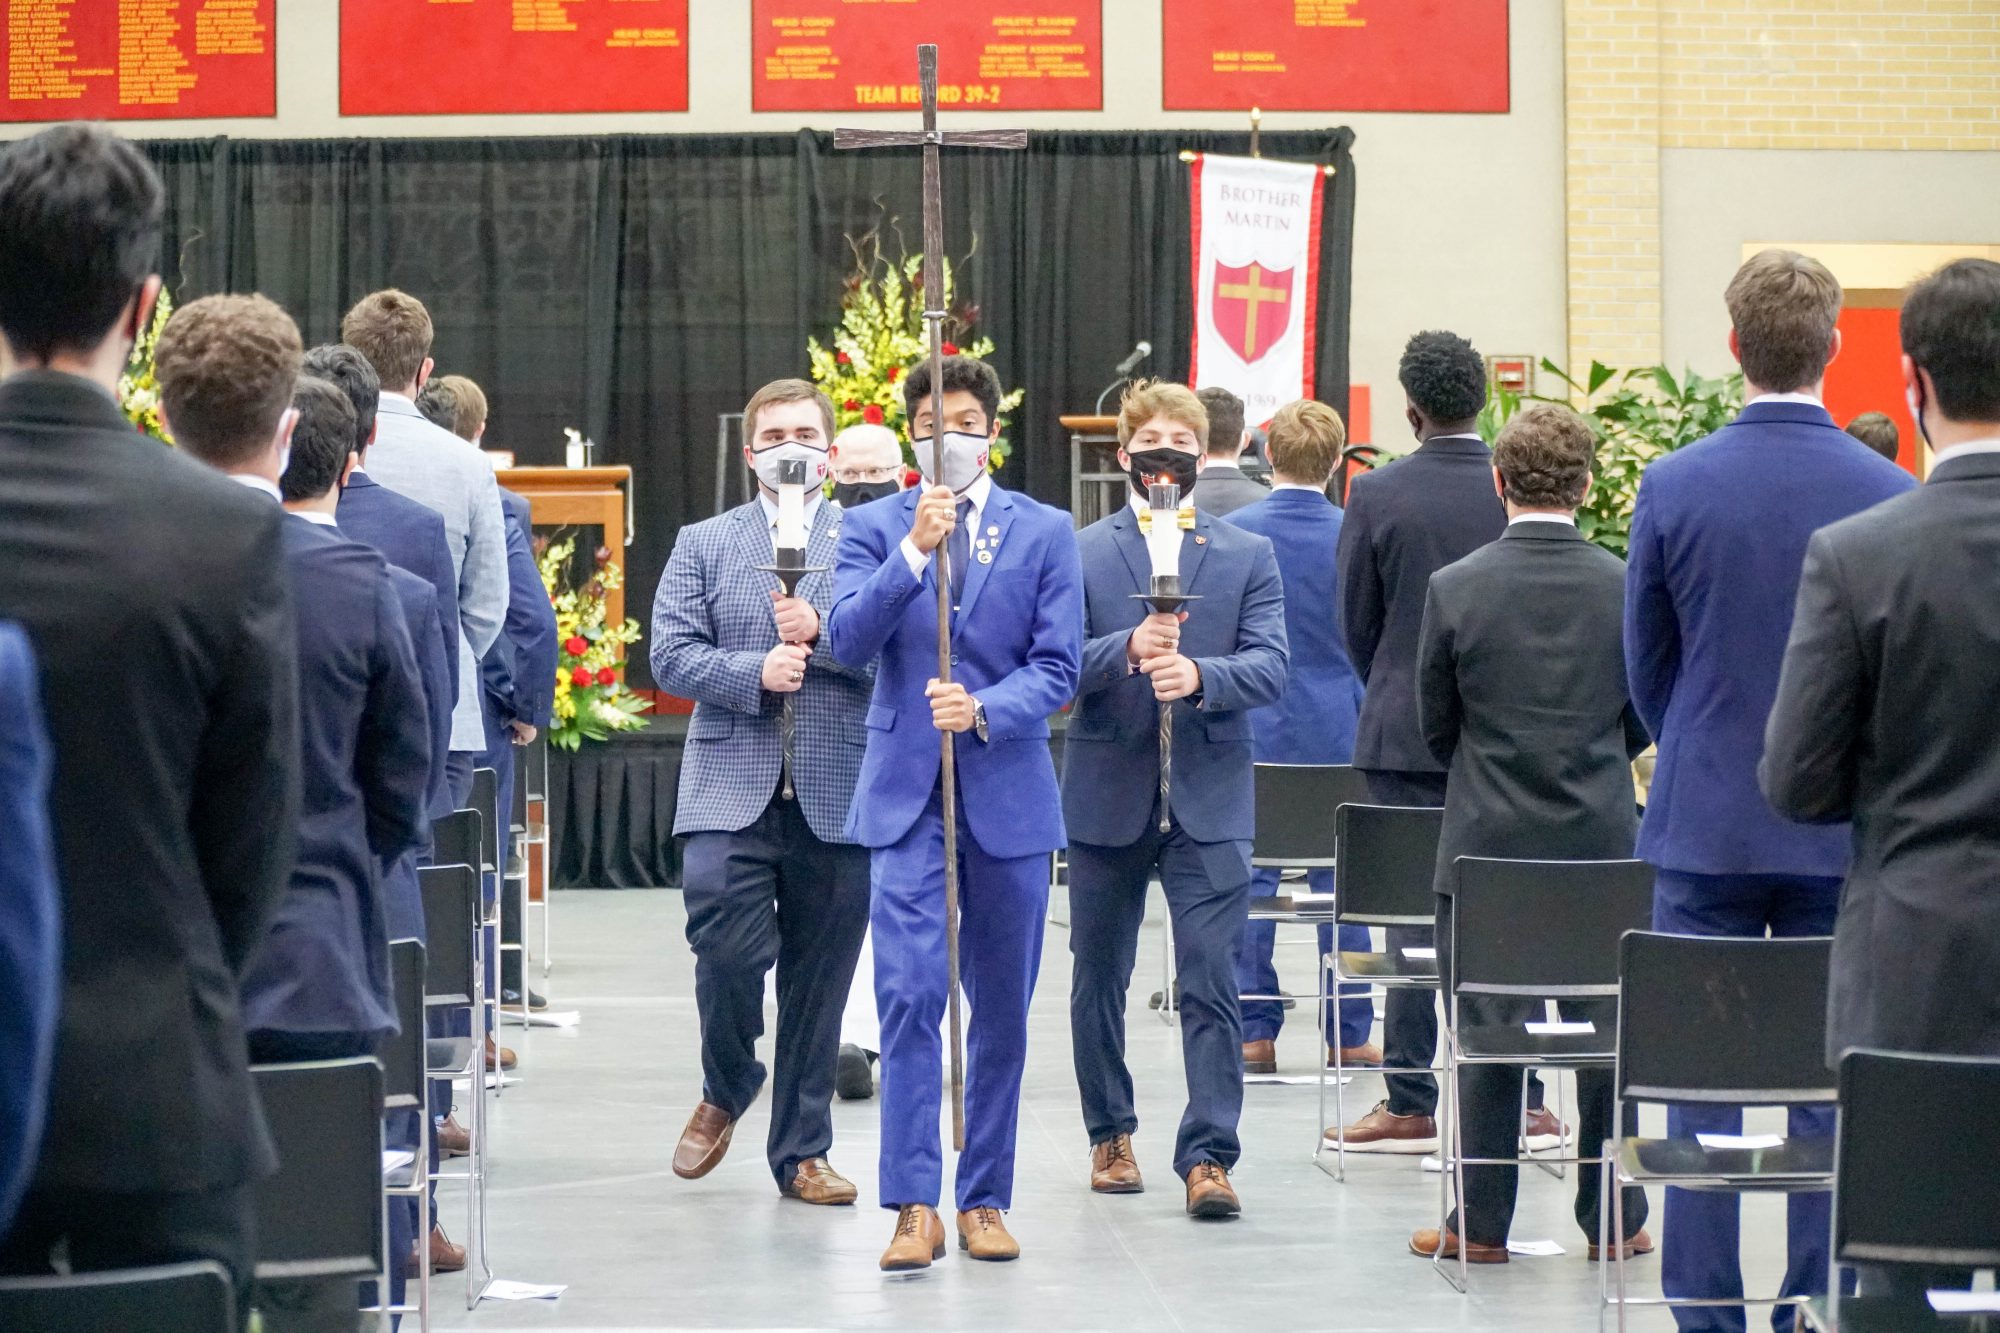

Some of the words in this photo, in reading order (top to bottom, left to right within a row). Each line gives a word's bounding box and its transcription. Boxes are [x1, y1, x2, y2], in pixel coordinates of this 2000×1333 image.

[855, 84, 897, 104] TEAM
[900, 84, 962, 104] RERD
[965, 84, 1001, 104] 39-2
[1220, 183, 1301, 207] BROTHER
[1224, 210, 1291, 231] MARTIN
